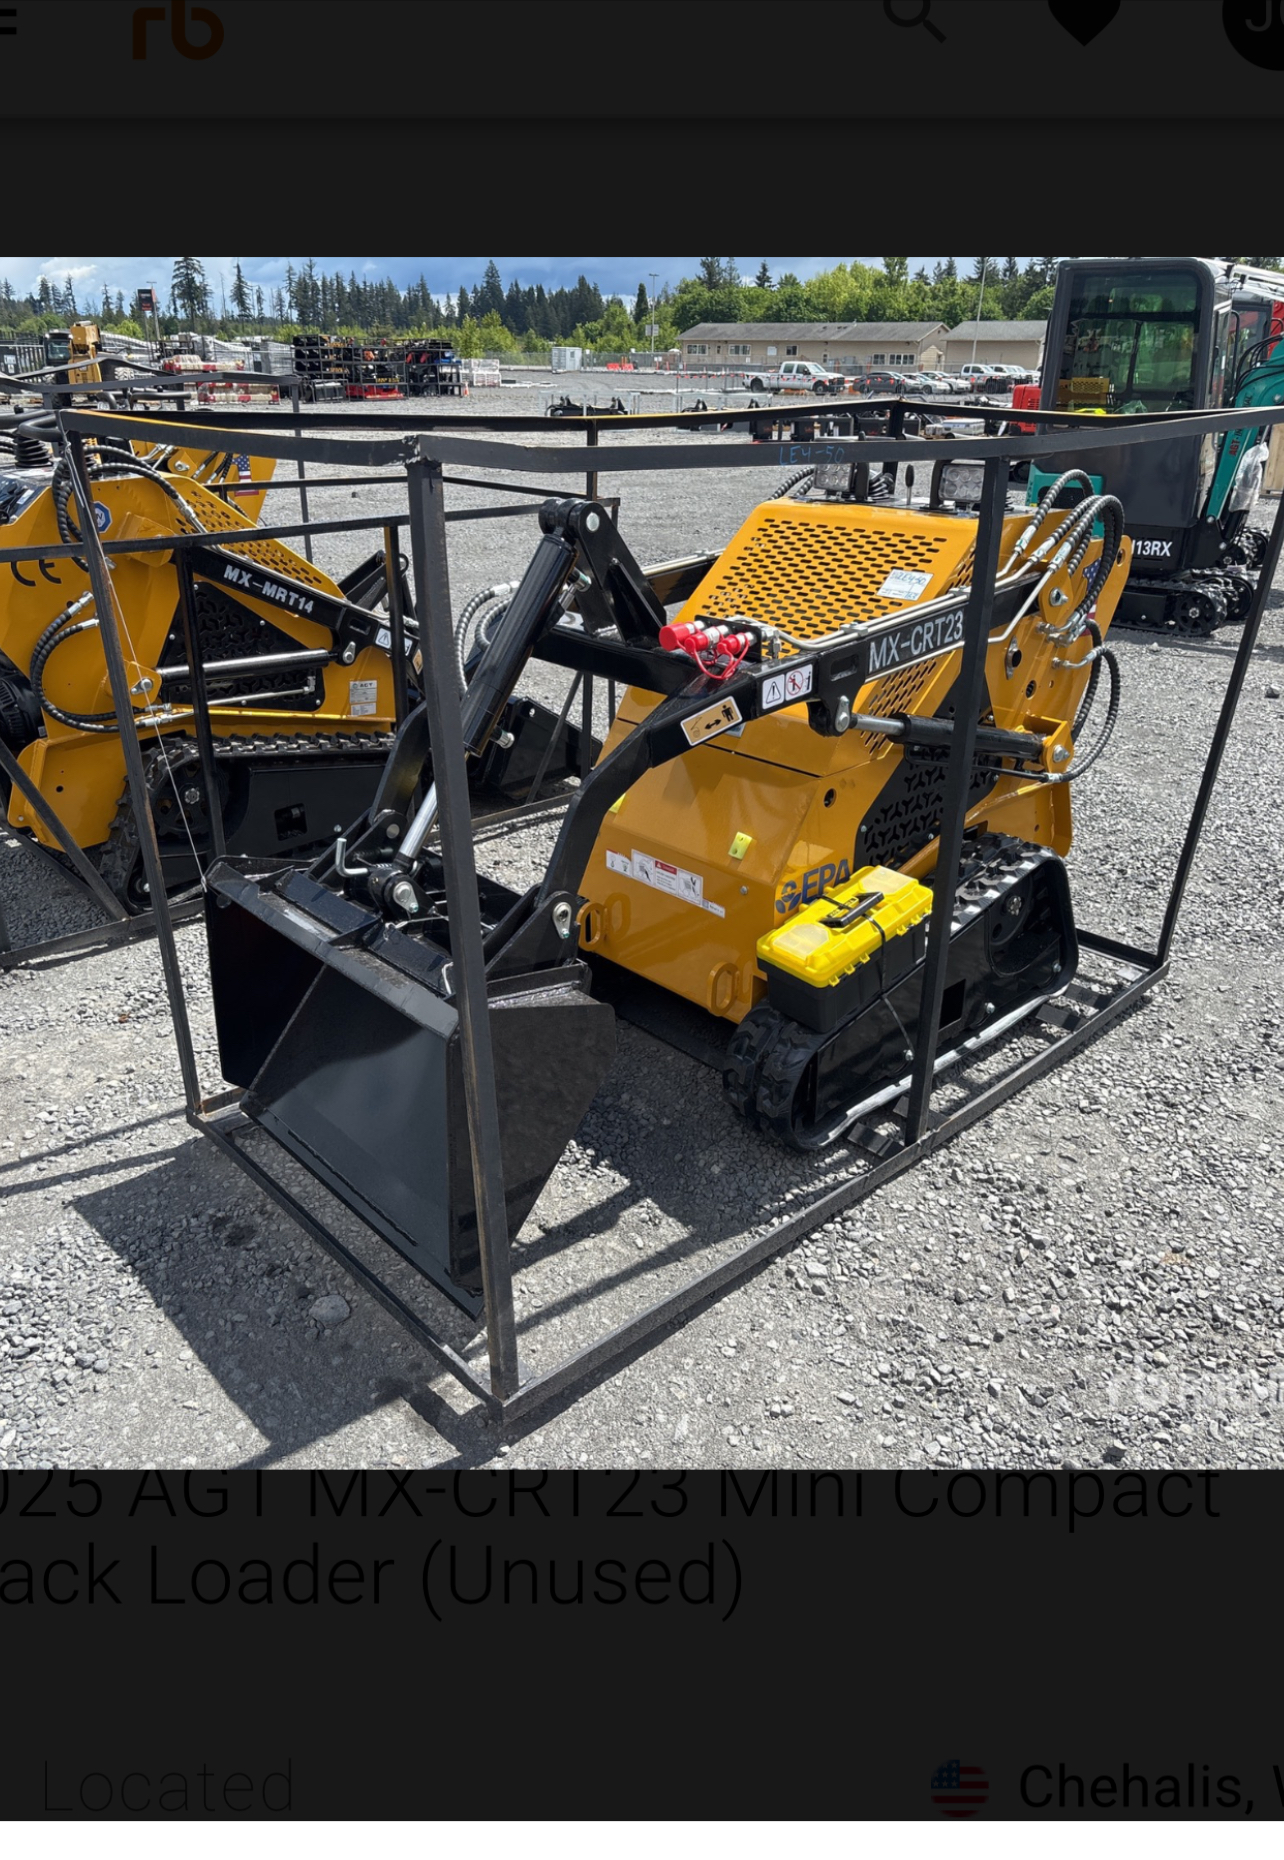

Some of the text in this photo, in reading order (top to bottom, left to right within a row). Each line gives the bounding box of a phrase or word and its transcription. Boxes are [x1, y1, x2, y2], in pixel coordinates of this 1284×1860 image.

[779, 445, 845, 466] LE4-50
[1131, 539, 1173, 557] 13RX
[223, 564, 314, 613] MX-MRT14
[869, 610, 964, 673] MX-CRT23
[802, 858, 850, 903] EPA
